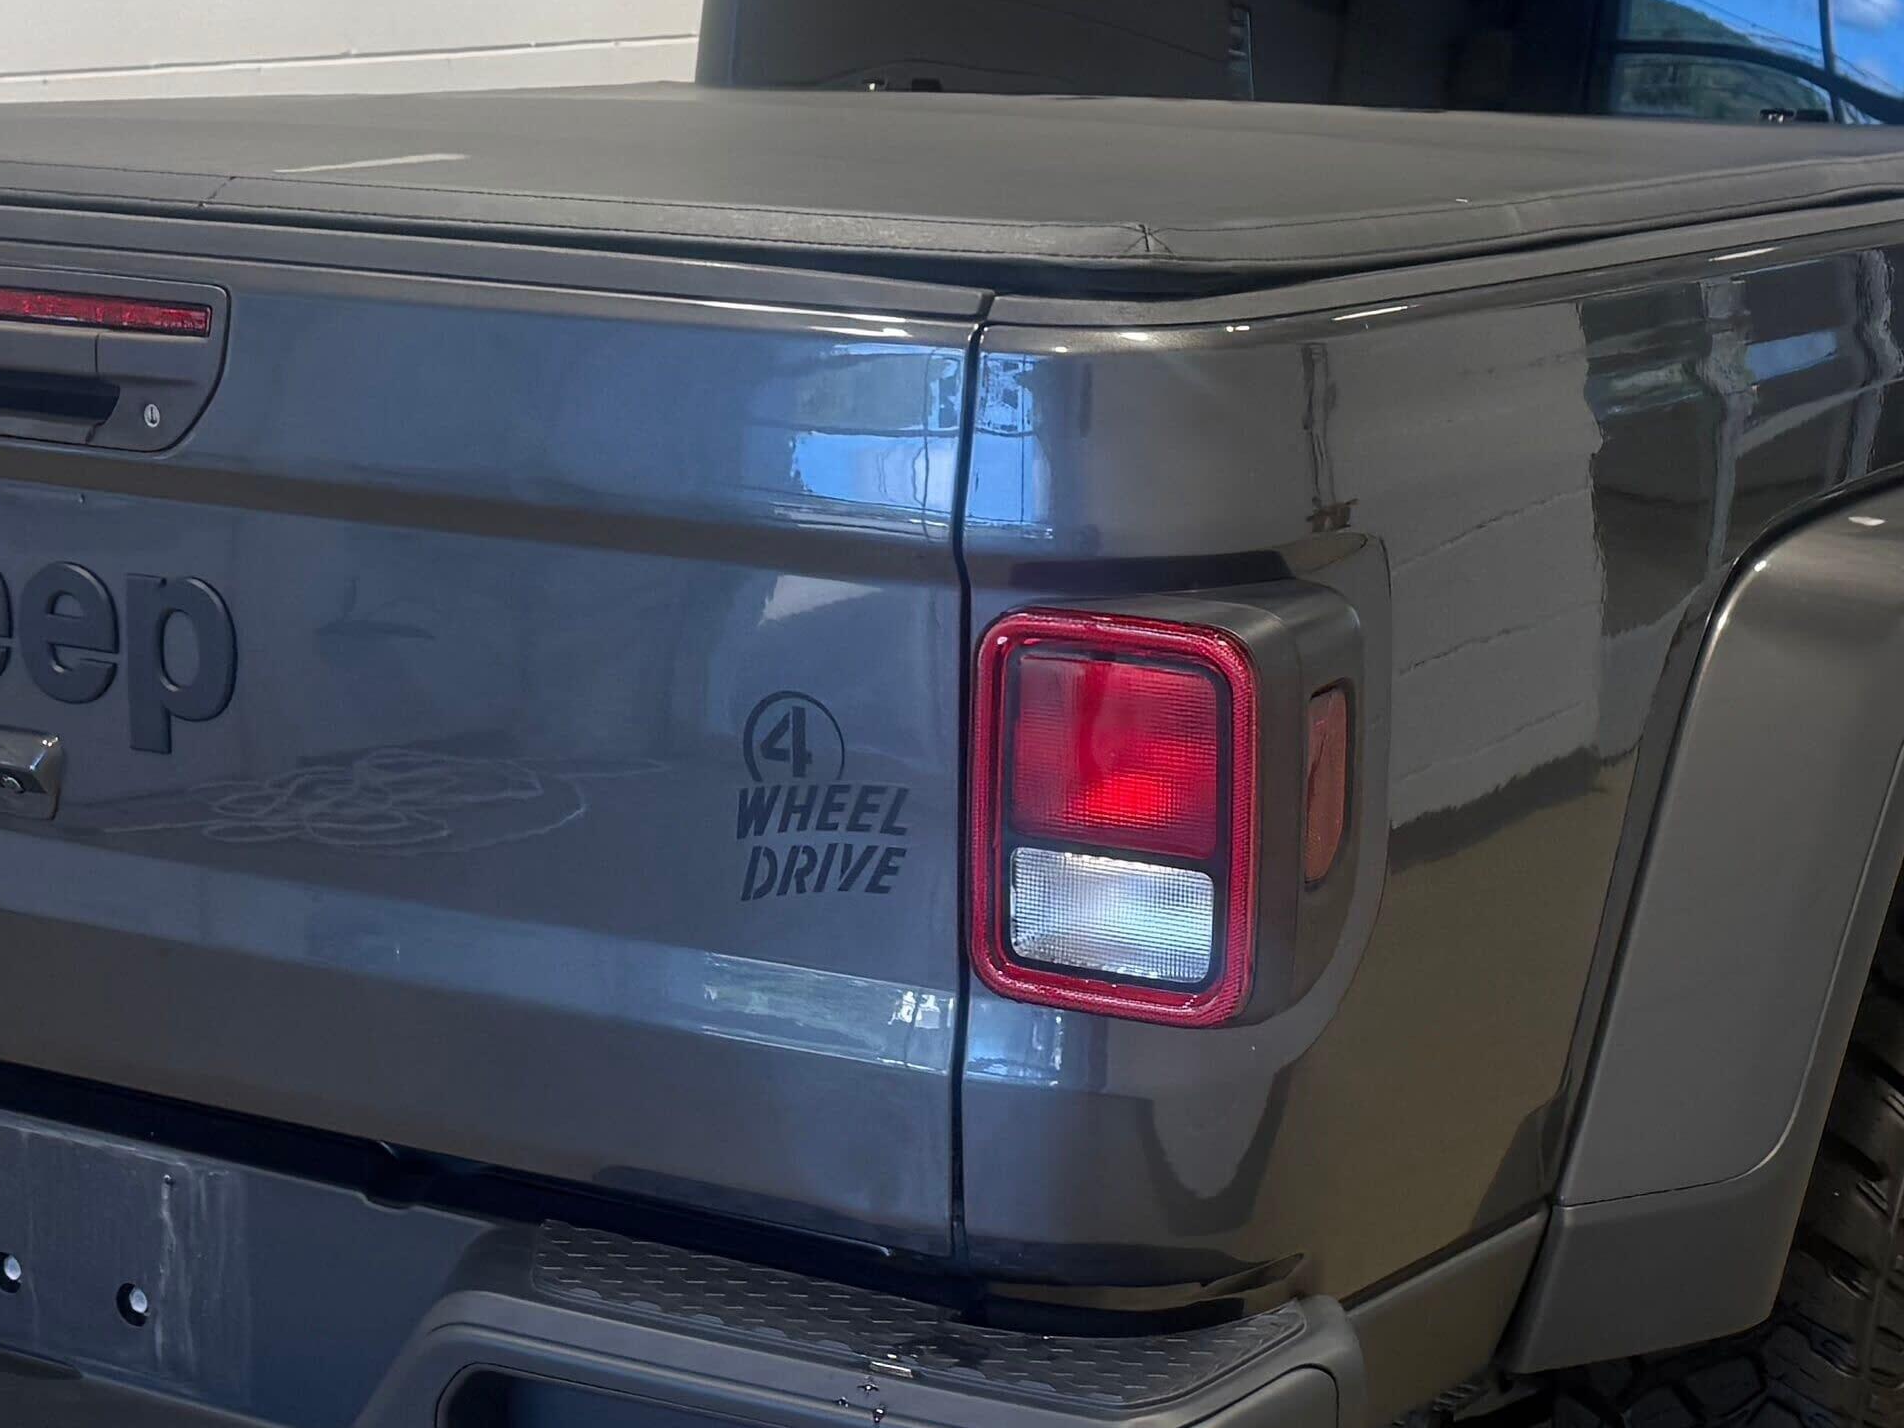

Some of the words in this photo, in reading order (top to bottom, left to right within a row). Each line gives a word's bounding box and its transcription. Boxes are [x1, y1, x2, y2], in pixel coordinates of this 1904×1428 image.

[760, 706, 813, 779] 4
[736, 783, 910, 840] WHEEL
[740, 842, 908, 902] DRIVE
